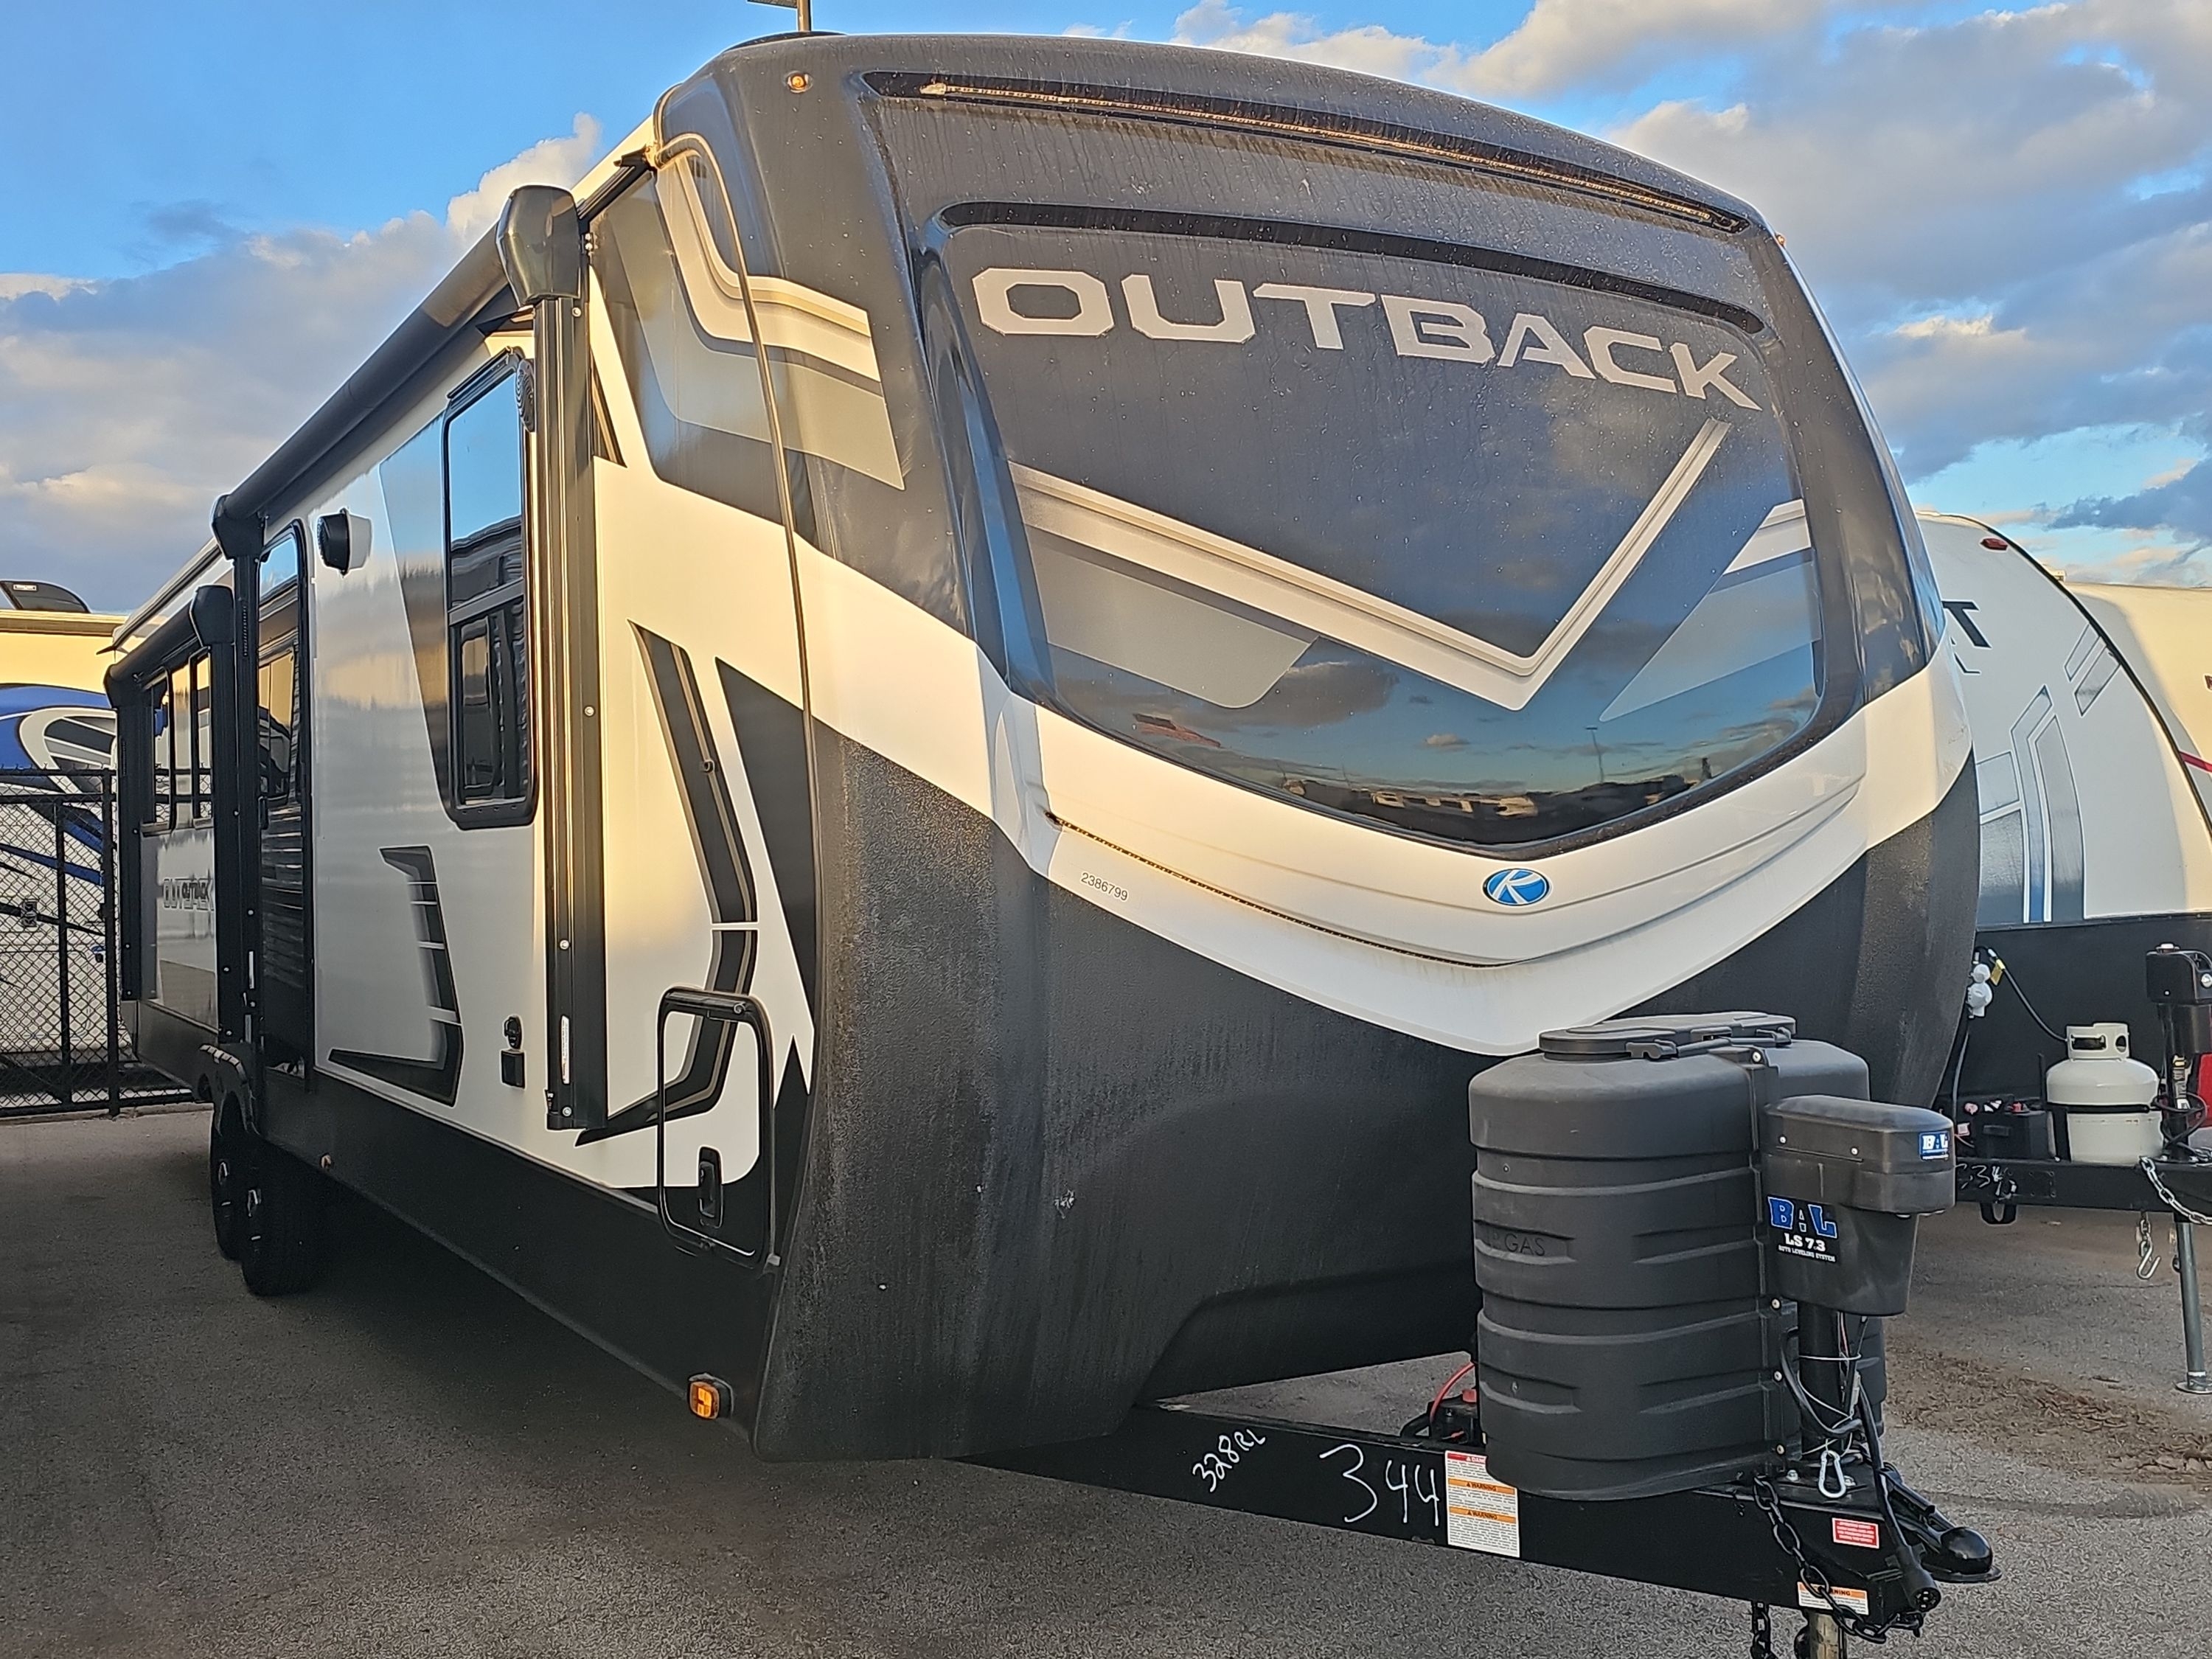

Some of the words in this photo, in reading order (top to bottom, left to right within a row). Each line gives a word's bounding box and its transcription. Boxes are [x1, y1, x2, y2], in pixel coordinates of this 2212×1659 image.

[971, 268, 1763, 411] OUTBACK
[1081, 872, 1128, 901] 2386799
[1921, 1134, 1949, 1150] BAL
[1767, 1196, 1837, 1239] BAL
[1504, 1233, 1545, 1256] GAS
[1784, 1233, 1804, 1248] LS
[1318, 1444, 1440, 1527] 344
[1472, 1482, 1498, 1492] WARNING
[1472, 1511, 1498, 1520] WARNING
